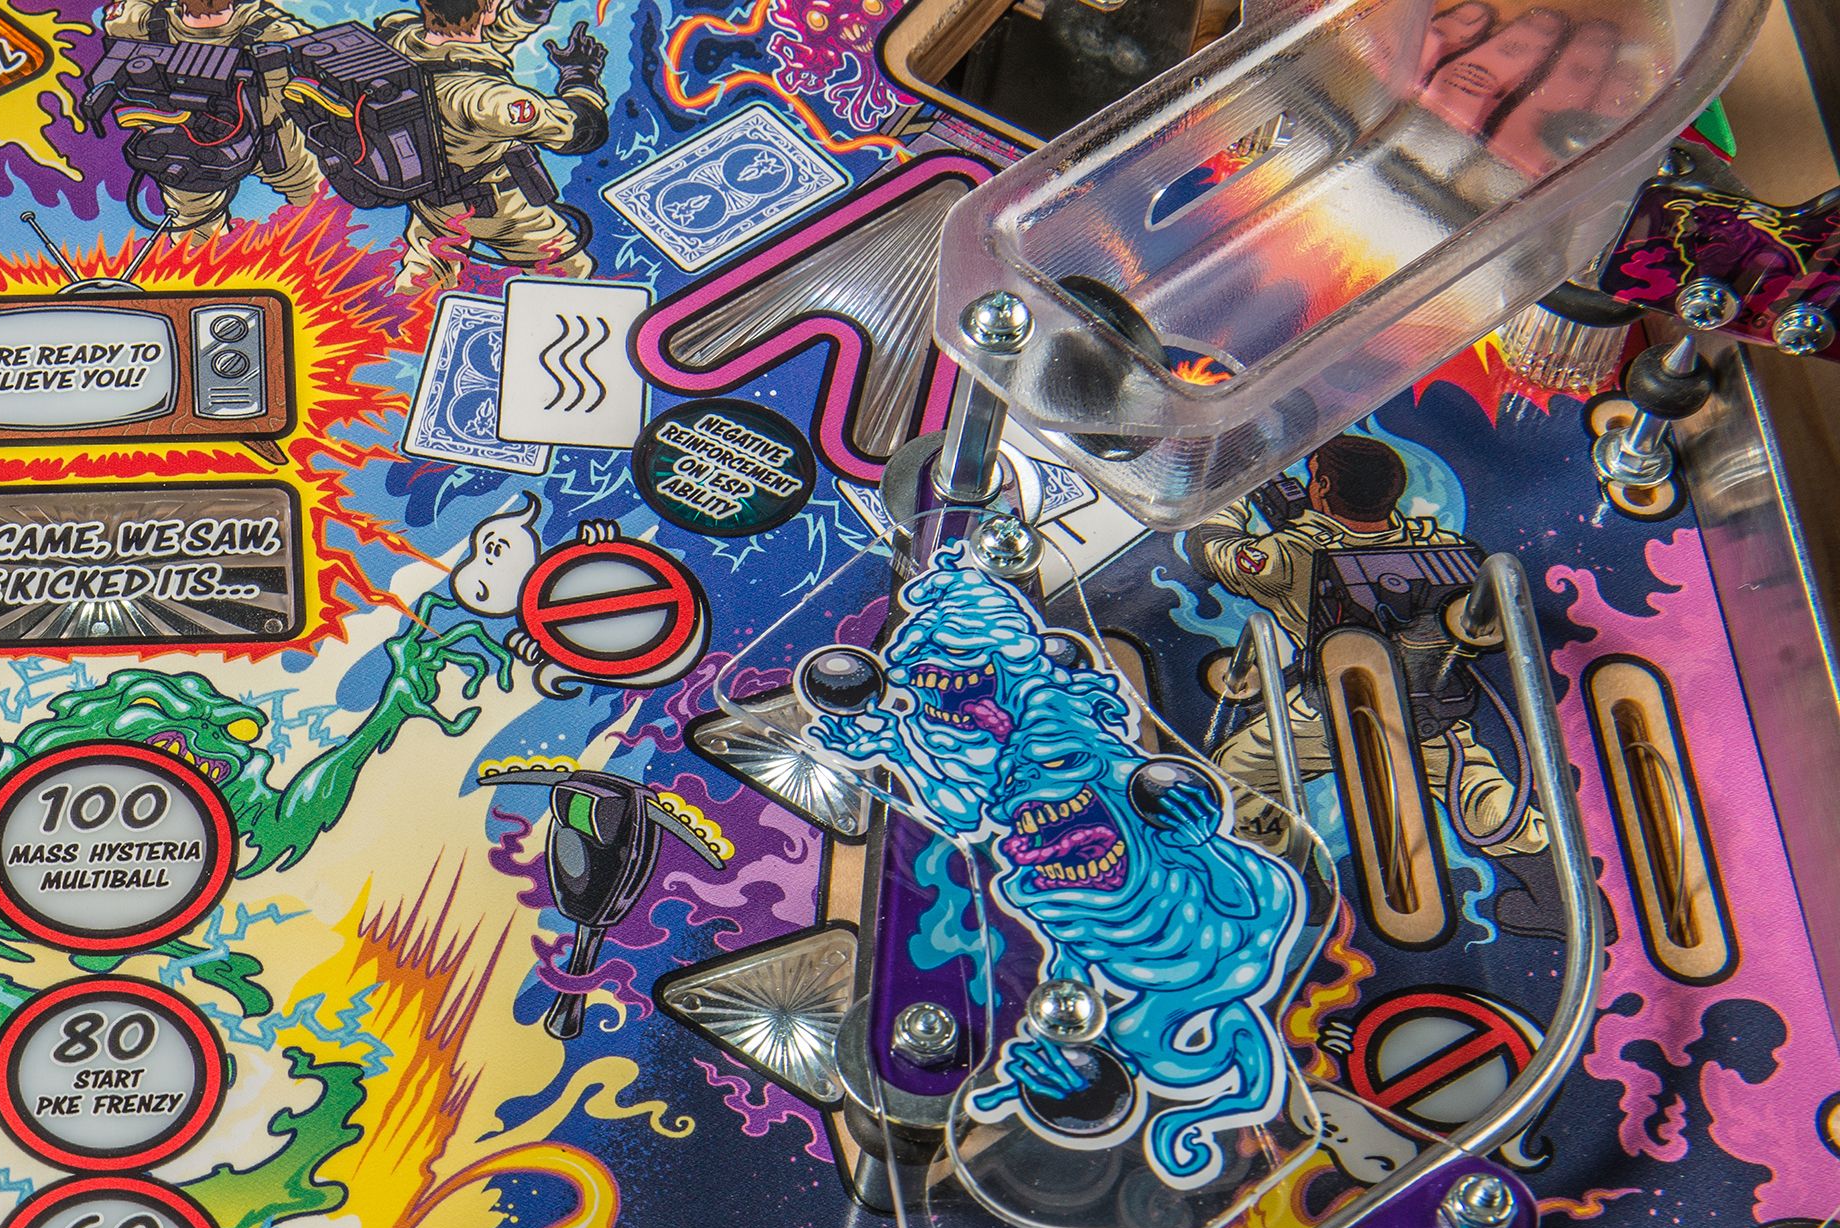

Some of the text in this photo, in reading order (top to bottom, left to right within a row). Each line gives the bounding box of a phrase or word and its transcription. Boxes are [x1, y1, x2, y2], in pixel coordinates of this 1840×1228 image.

[37, 344, 121, 367] READY
[123, 344, 161, 363] TO
[80, 368, 146, 390] YOU!
[659, 423, 802, 495] REINFORCEMENT
[695, 415, 792, 465] NEGATIVE
[676, 457, 752, 498] ON ESP
[660, 477, 740, 517] ABILITY
[118, 520, 183, 556] WE
[183, 518, 281, 556] SAW,
[5, 567, 152, 604] KICKED
[154, 565, 260, 600] ITS...
[39, 782, 169, 834] 100
[8, 841, 202, 866] MASS HYSTERIA
[40, 869, 169, 891] MULTIBALL
[52, 1011, 158, 1065] 80
[72, 1069, 145, 1090] START
[35, 1093, 185, 1116] PKE FRENZY
